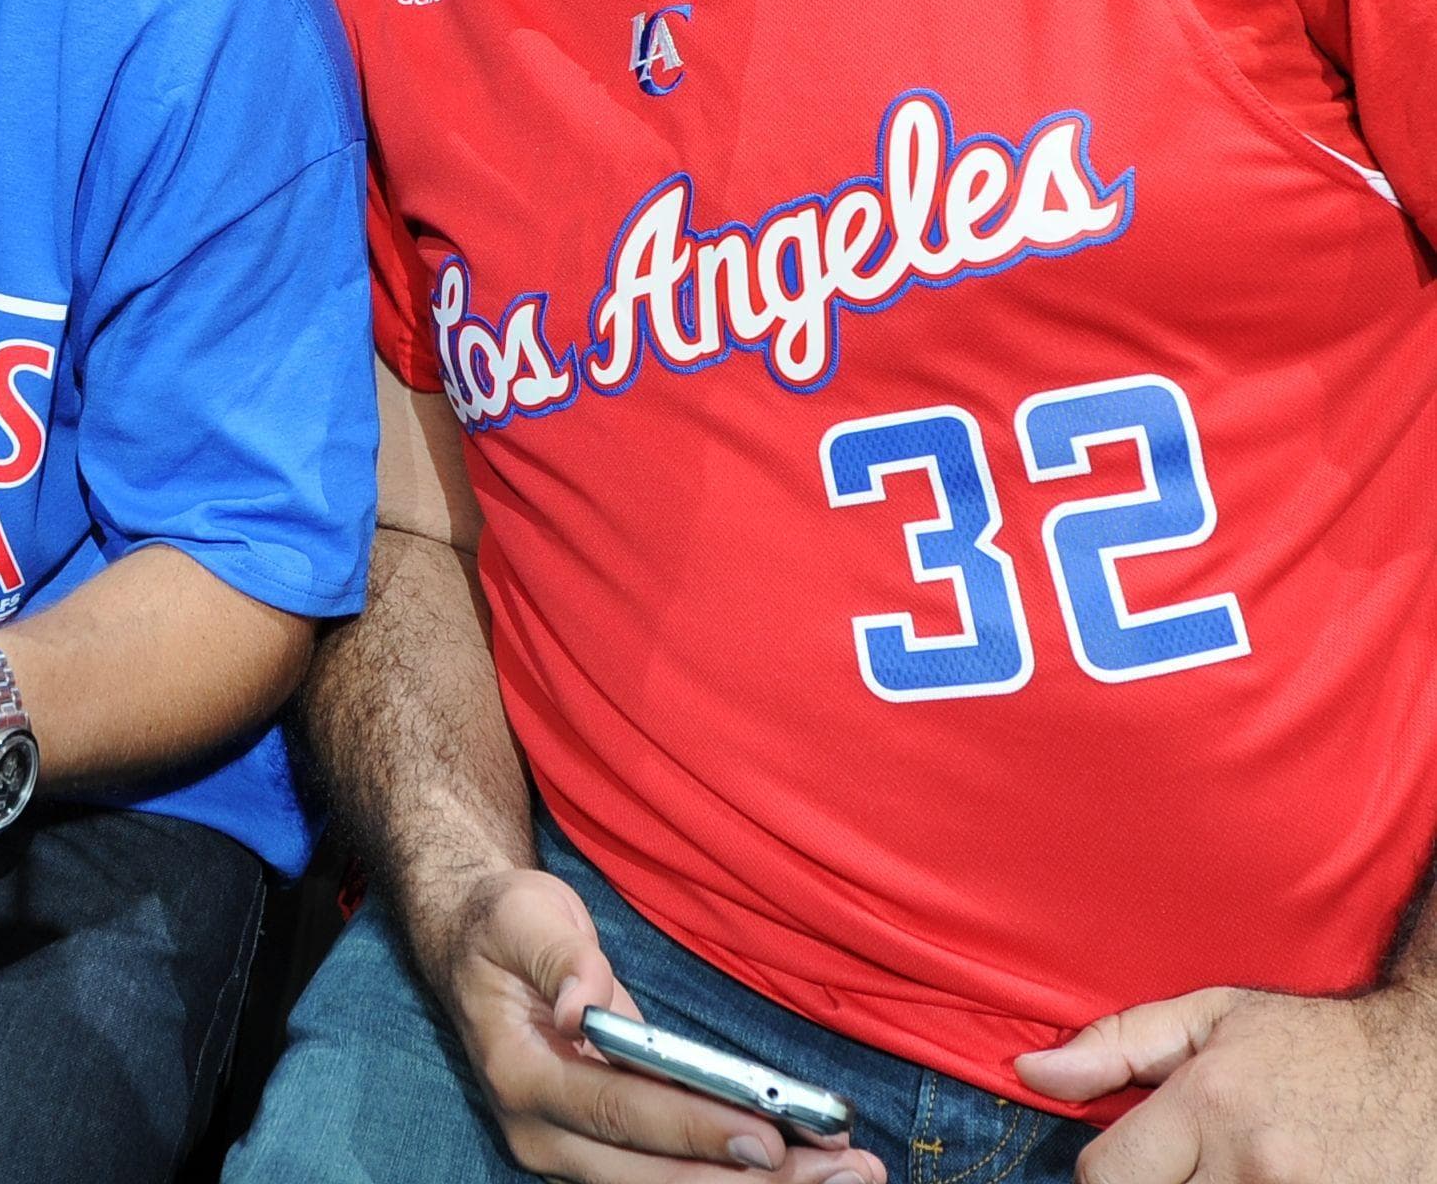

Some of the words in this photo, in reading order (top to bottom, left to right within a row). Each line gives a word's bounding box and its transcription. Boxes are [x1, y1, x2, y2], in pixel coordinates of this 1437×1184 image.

[431, 256, 575, 430] Los
[585, 92, 1131, 391] Angeles
[819, 374, 1251, 703] 32
